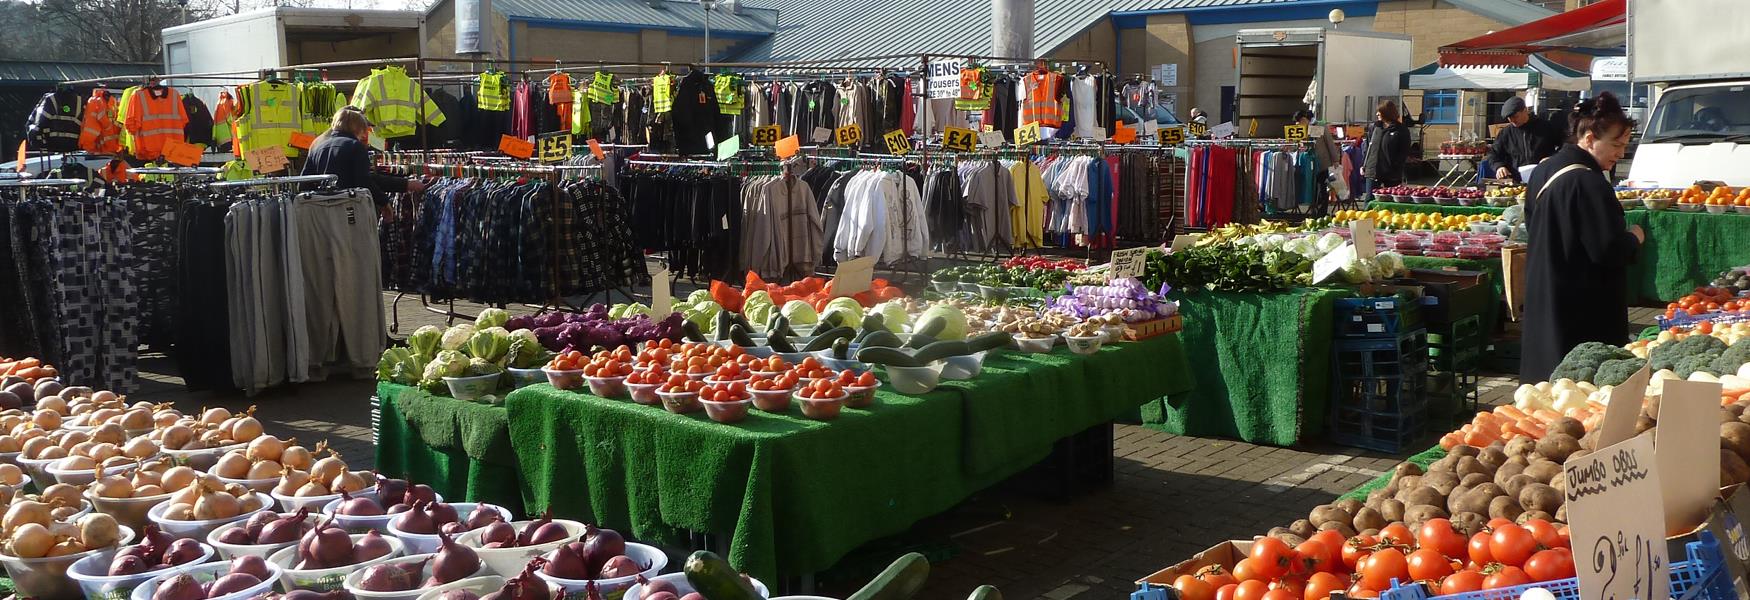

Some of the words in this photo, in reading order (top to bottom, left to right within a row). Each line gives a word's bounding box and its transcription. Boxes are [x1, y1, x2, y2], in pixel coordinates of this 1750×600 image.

[927, 61, 960, 78] MENS
[755, 128, 778, 143] £8
[839, 126, 857, 142] £6
[947, 130, 972, 151] £4
[1018, 125, 1037, 143] £4
[1161, 129, 1182, 142] £5
[1287, 127, 1305, 139] £5
[542, 137, 567, 158] £5
[887, 133, 908, 152] £10
[1567, 458, 1607, 489] JUMBO
[316, 573, 348, 585] Mixin
[323, 582, 344, 591] Bow
